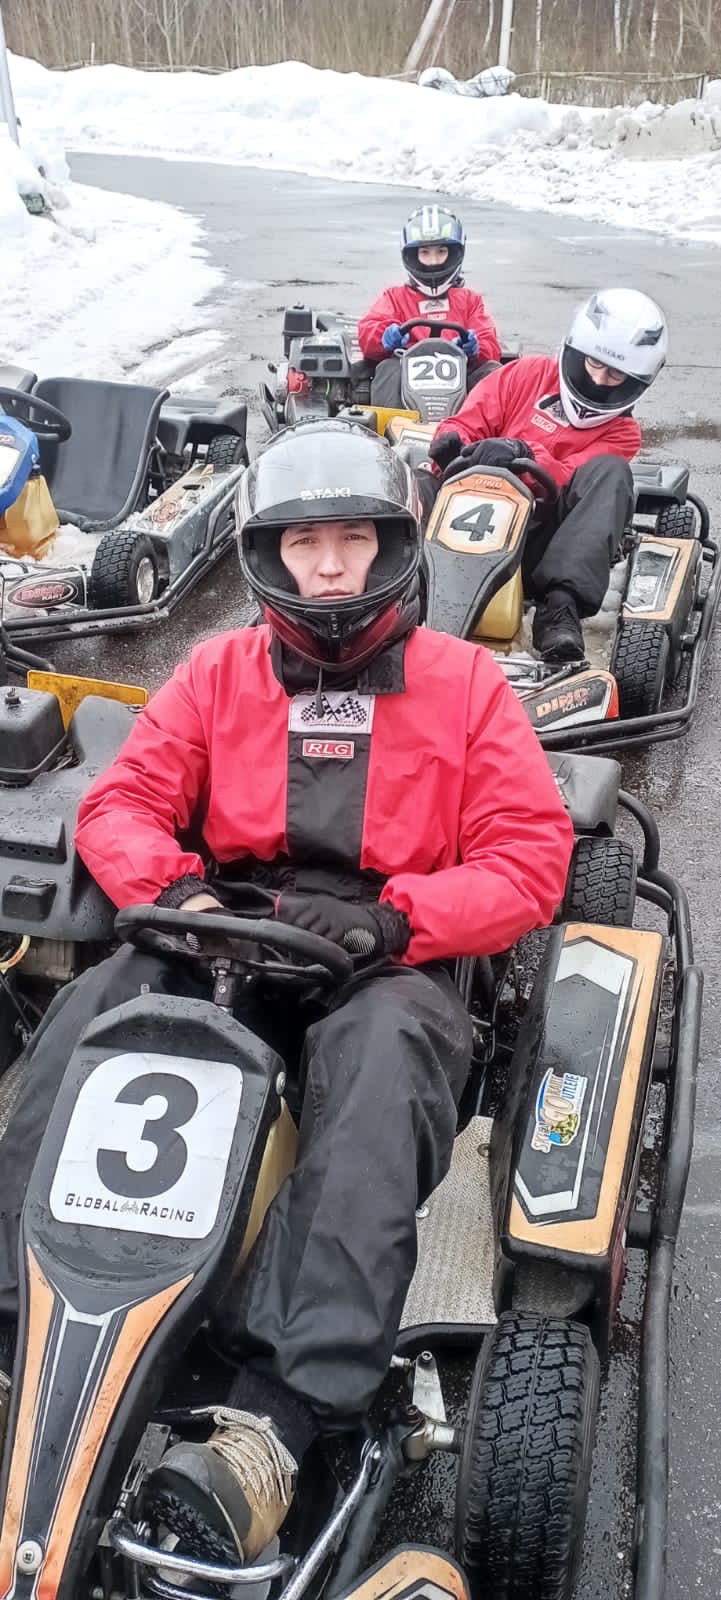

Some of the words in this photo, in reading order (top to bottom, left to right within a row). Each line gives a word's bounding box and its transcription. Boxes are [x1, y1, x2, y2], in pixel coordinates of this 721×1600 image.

[412, 360, 458, 380] 20
[450, 503, 495, 541] 4
[307, 743, 350, 755] RLG
[562, 1074, 579, 1100] UTLEIE
[96, 1072, 199, 1199] 3
[64, 1193, 119, 1212] GLOBAL
[139, 1202, 196, 1222] RACING
